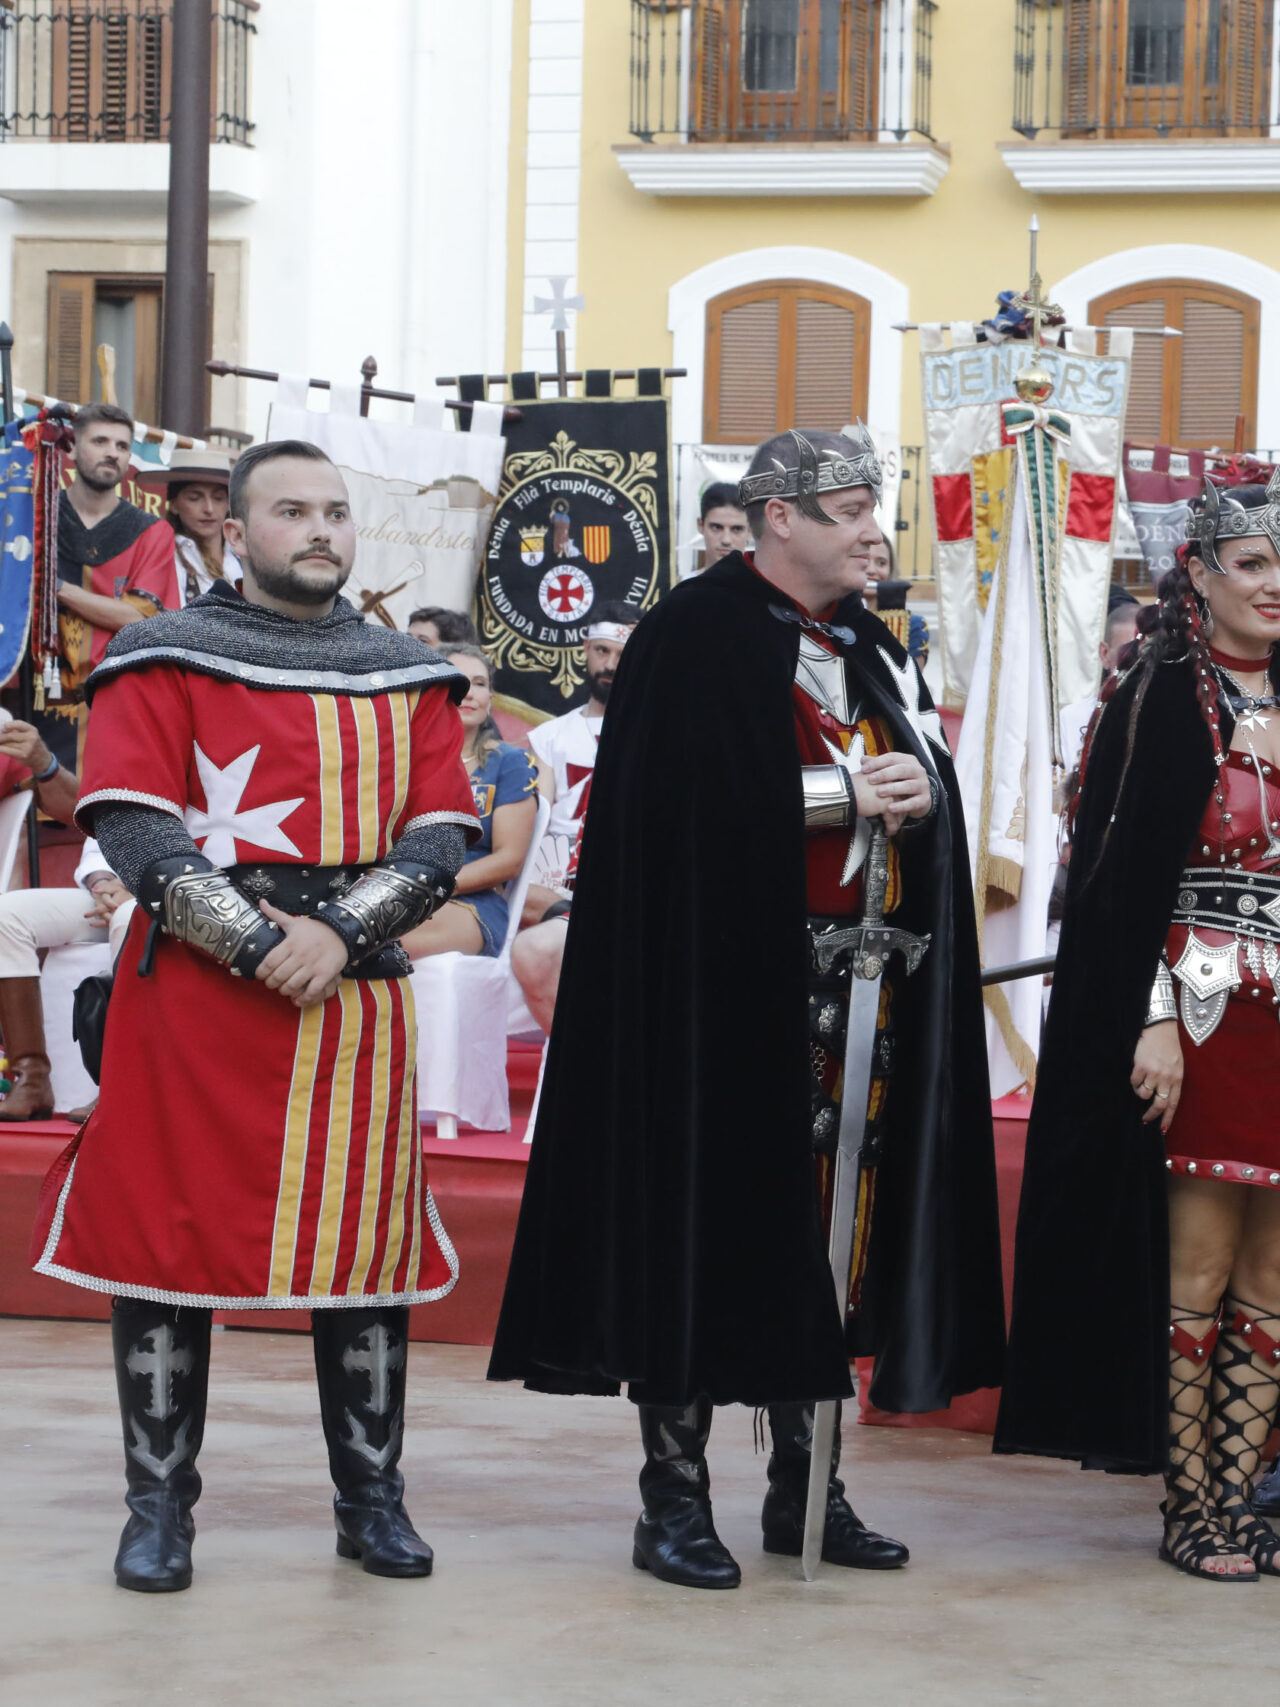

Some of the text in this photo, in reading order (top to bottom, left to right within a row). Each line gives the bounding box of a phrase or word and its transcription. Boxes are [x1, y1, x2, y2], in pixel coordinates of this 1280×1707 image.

[931, 348, 1118, 406] DENRS
[488, 478, 649, 560] Dénia Filà Templaris Dénia
[488, 575, 535, 636] FUNDADA
[538, 626, 559, 643] EN
